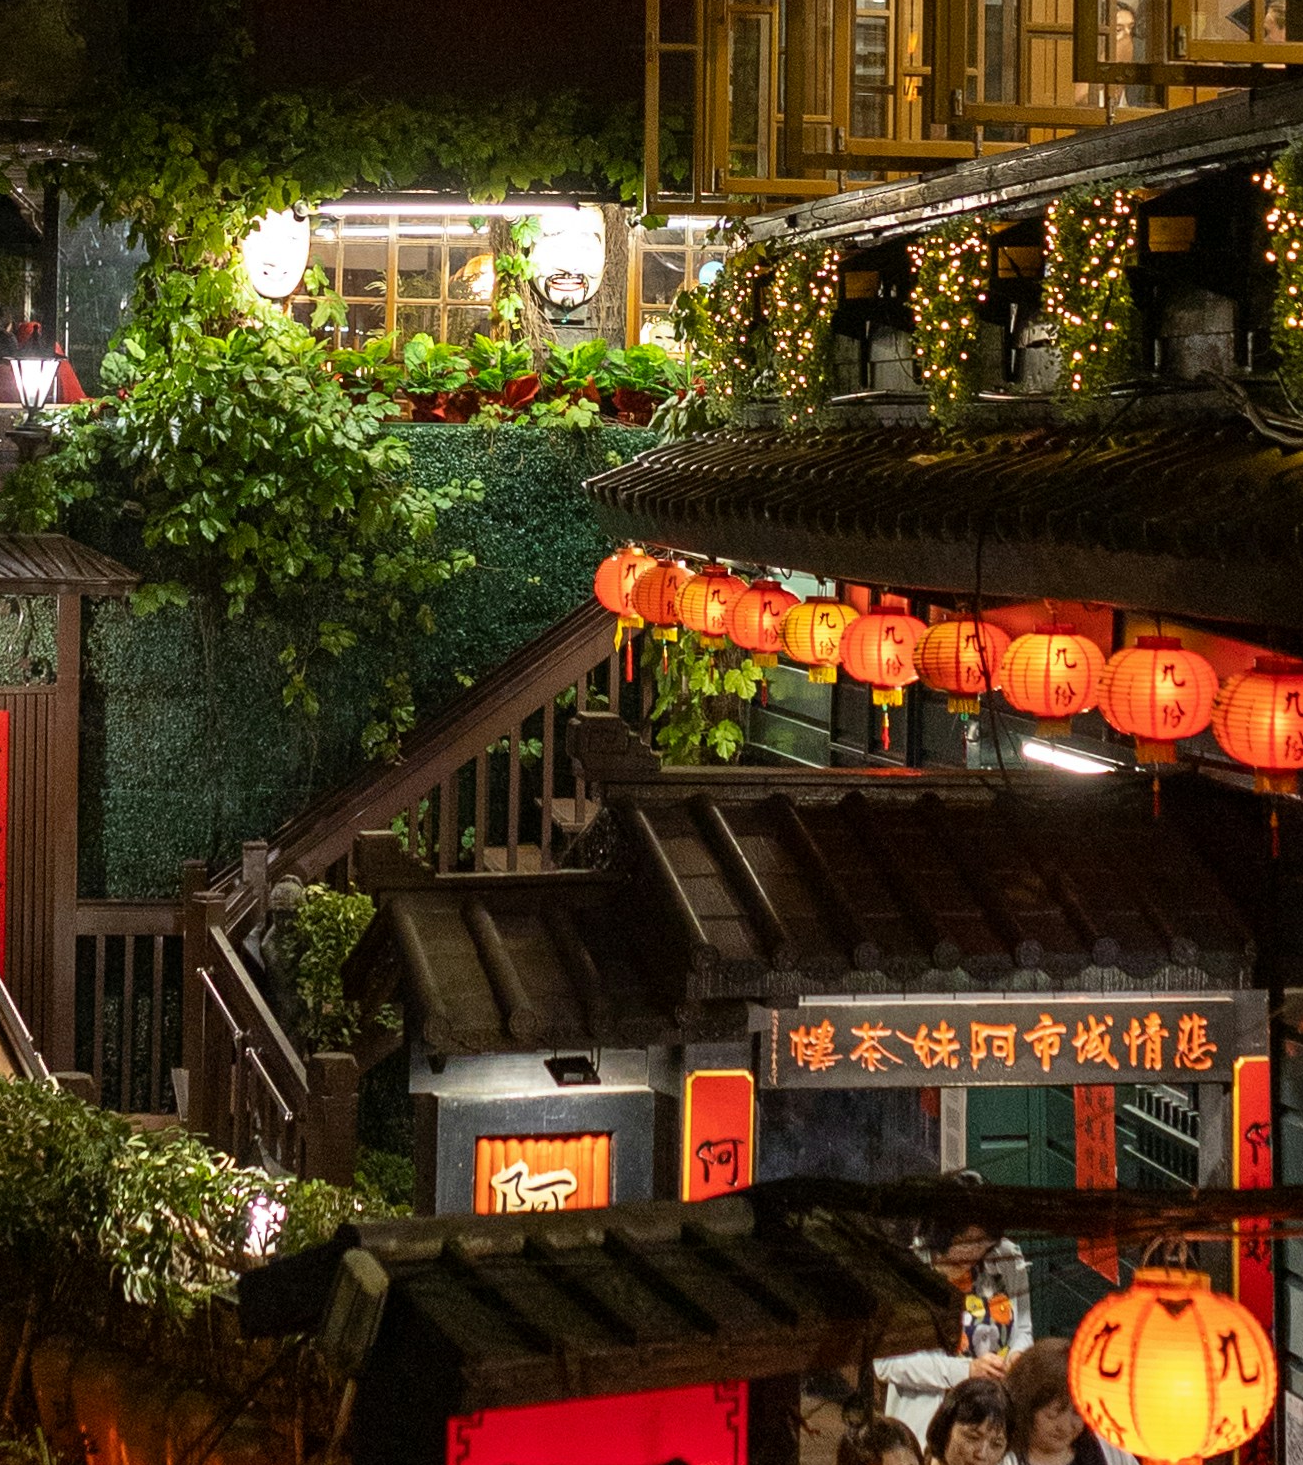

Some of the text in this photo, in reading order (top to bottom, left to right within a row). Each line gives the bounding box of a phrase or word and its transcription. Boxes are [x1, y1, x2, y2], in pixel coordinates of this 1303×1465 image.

[709, 588, 726, 632] 九份
[763, 599, 779, 645] 九份
[818, 611, 836, 658] 九份
[883, 625, 904, 676] 九份
[1054, 647, 1077, 708] 九份
[1160, 664, 1187, 730] 九份
[697, 1139, 744, 1187] 阿
[1083, 1322, 1126, 1442] 九份
[1214, 1330, 1259, 1450] 九份
